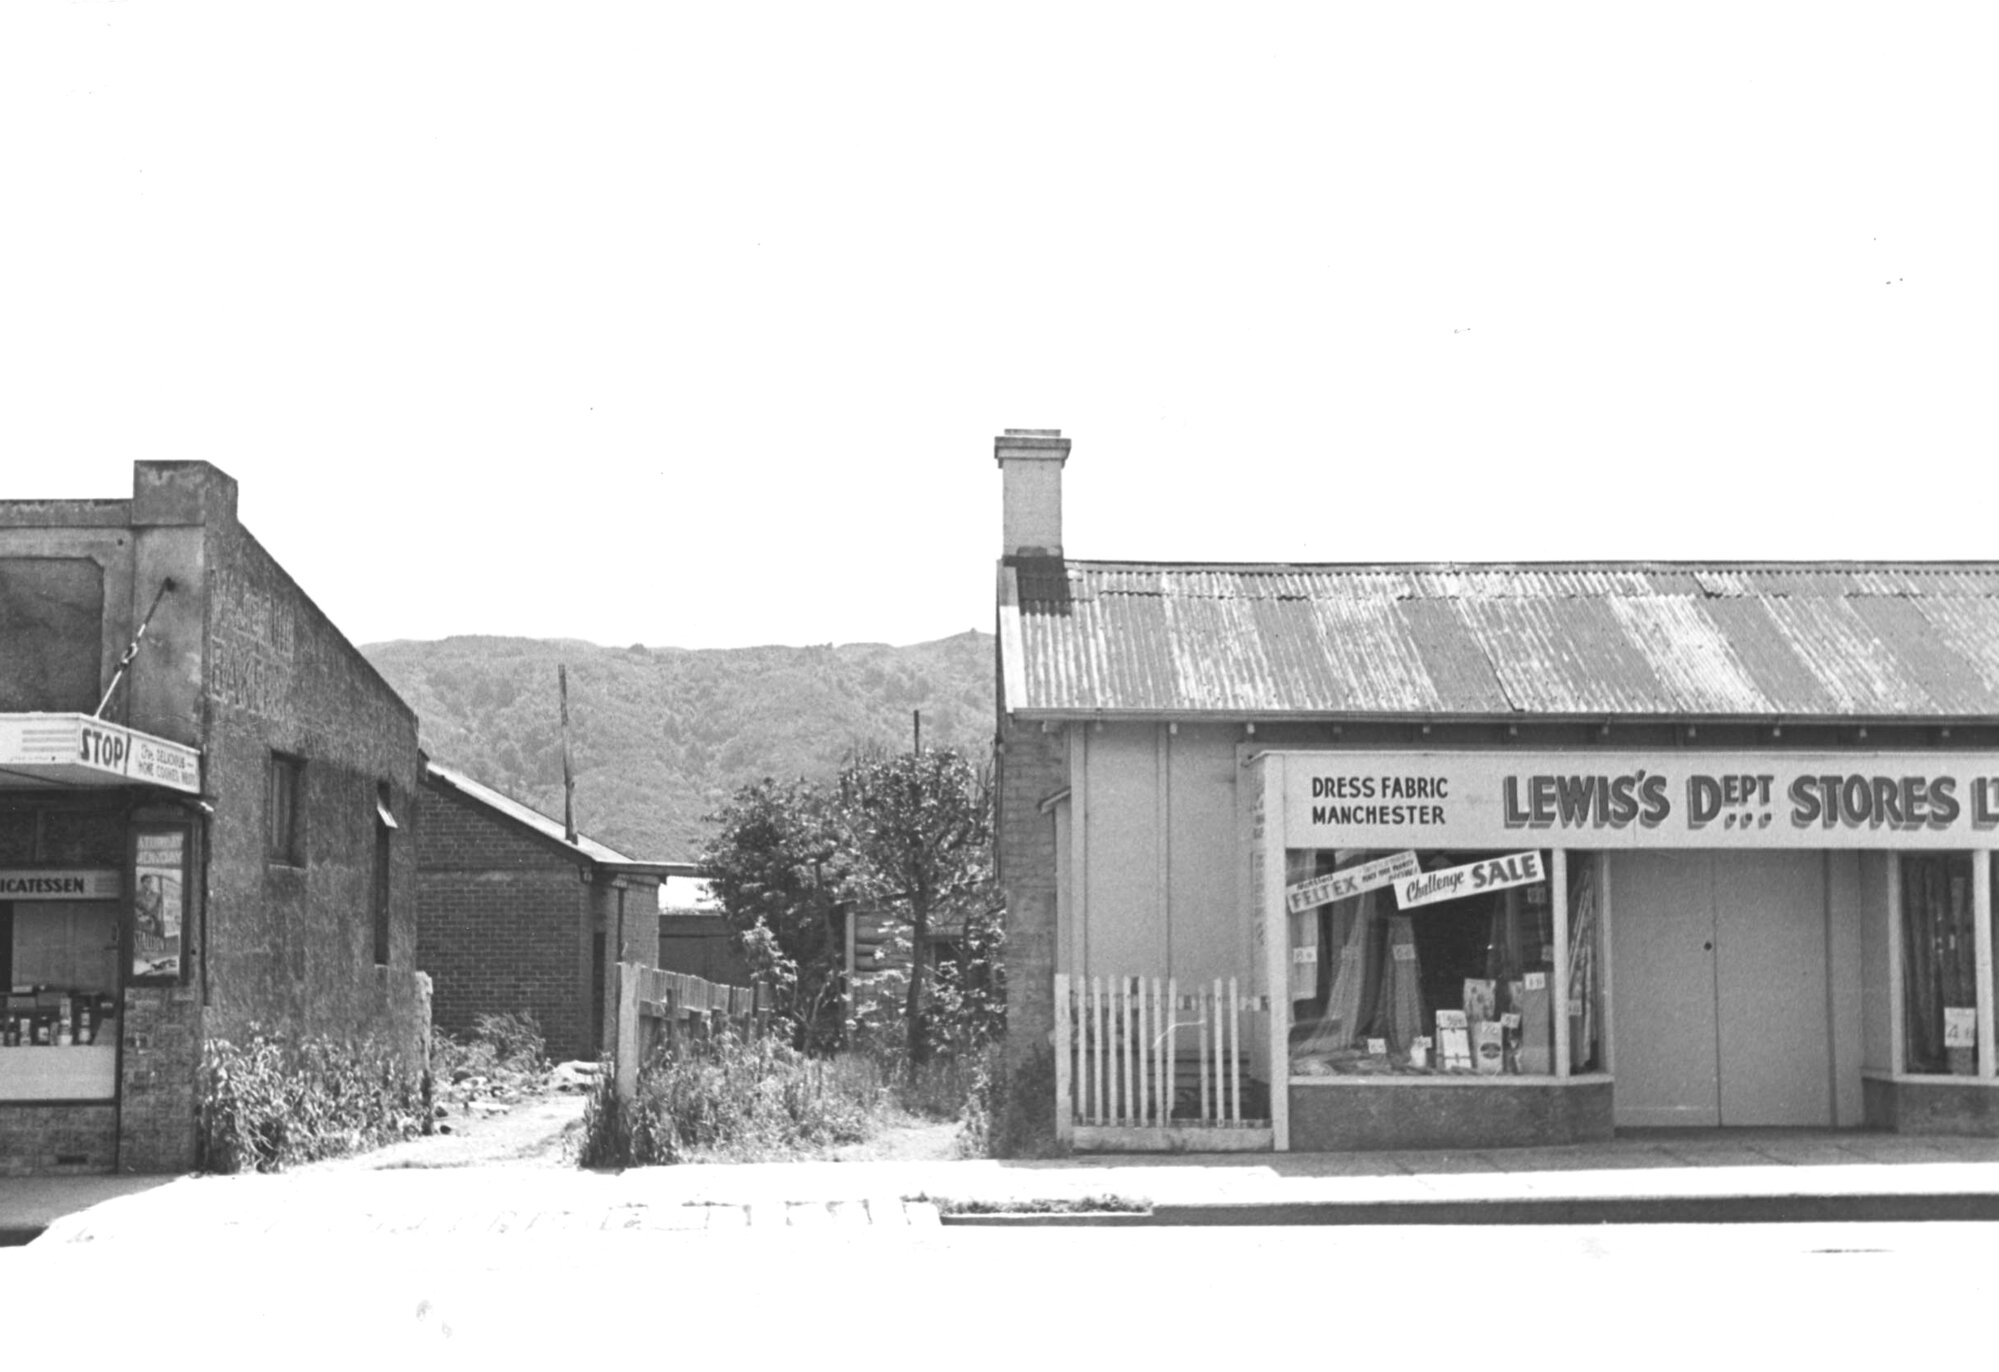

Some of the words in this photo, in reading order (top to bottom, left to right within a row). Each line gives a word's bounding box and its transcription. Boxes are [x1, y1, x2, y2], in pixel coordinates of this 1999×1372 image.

[1313, 777, 1375, 799] DRESS
[1381, 777, 1449, 799] FABRIC
[1504, 769, 1670, 829] LEWIS'S
[1789, 773, 1961, 830] STORES
[1313, 806, 1446, 826] MANCHESTER
[1291, 876, 1359, 911] FELTEX
[1406, 872, 1465, 903] Challenge
[1472, 854, 1537, 888] SALE
